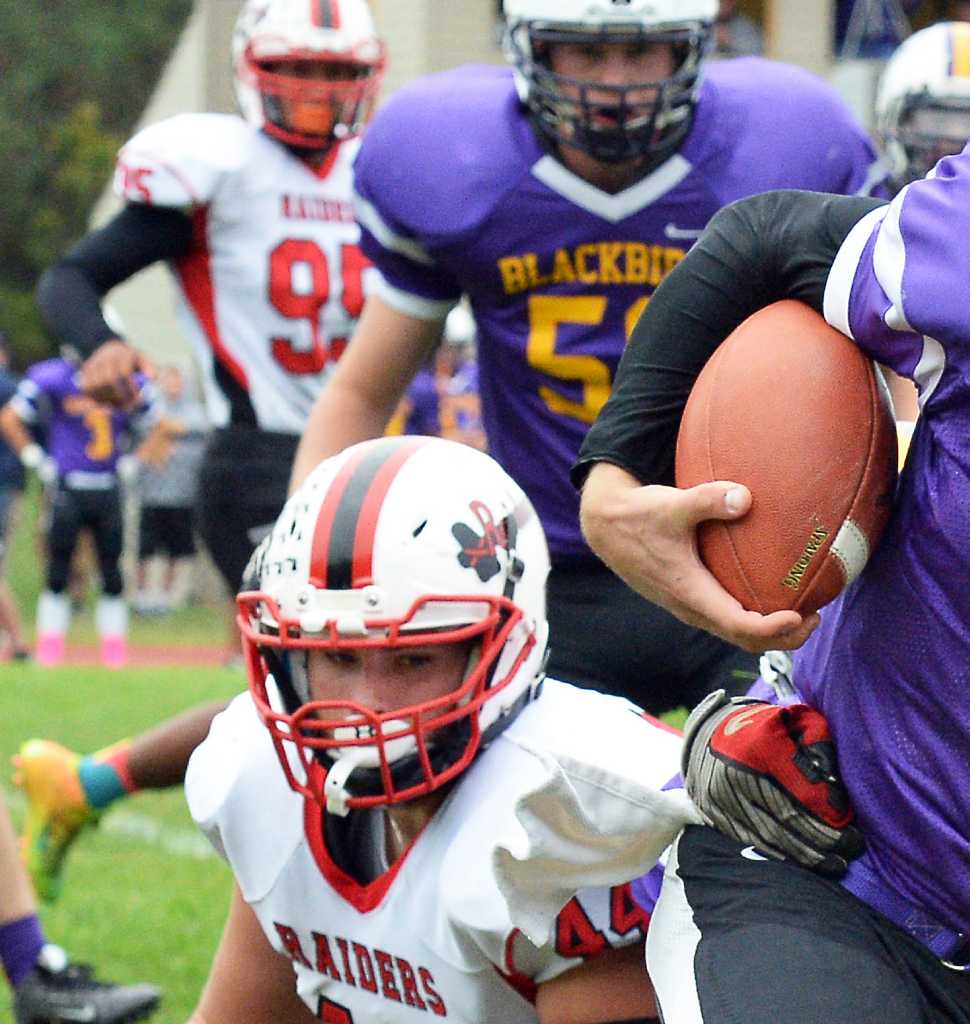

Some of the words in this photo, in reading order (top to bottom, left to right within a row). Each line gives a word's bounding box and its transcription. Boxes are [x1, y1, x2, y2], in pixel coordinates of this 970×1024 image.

[526, 295, 652, 424] 5
[781, 526, 828, 591] SPALDING
[273, 921, 448, 1017] RAIDERS
